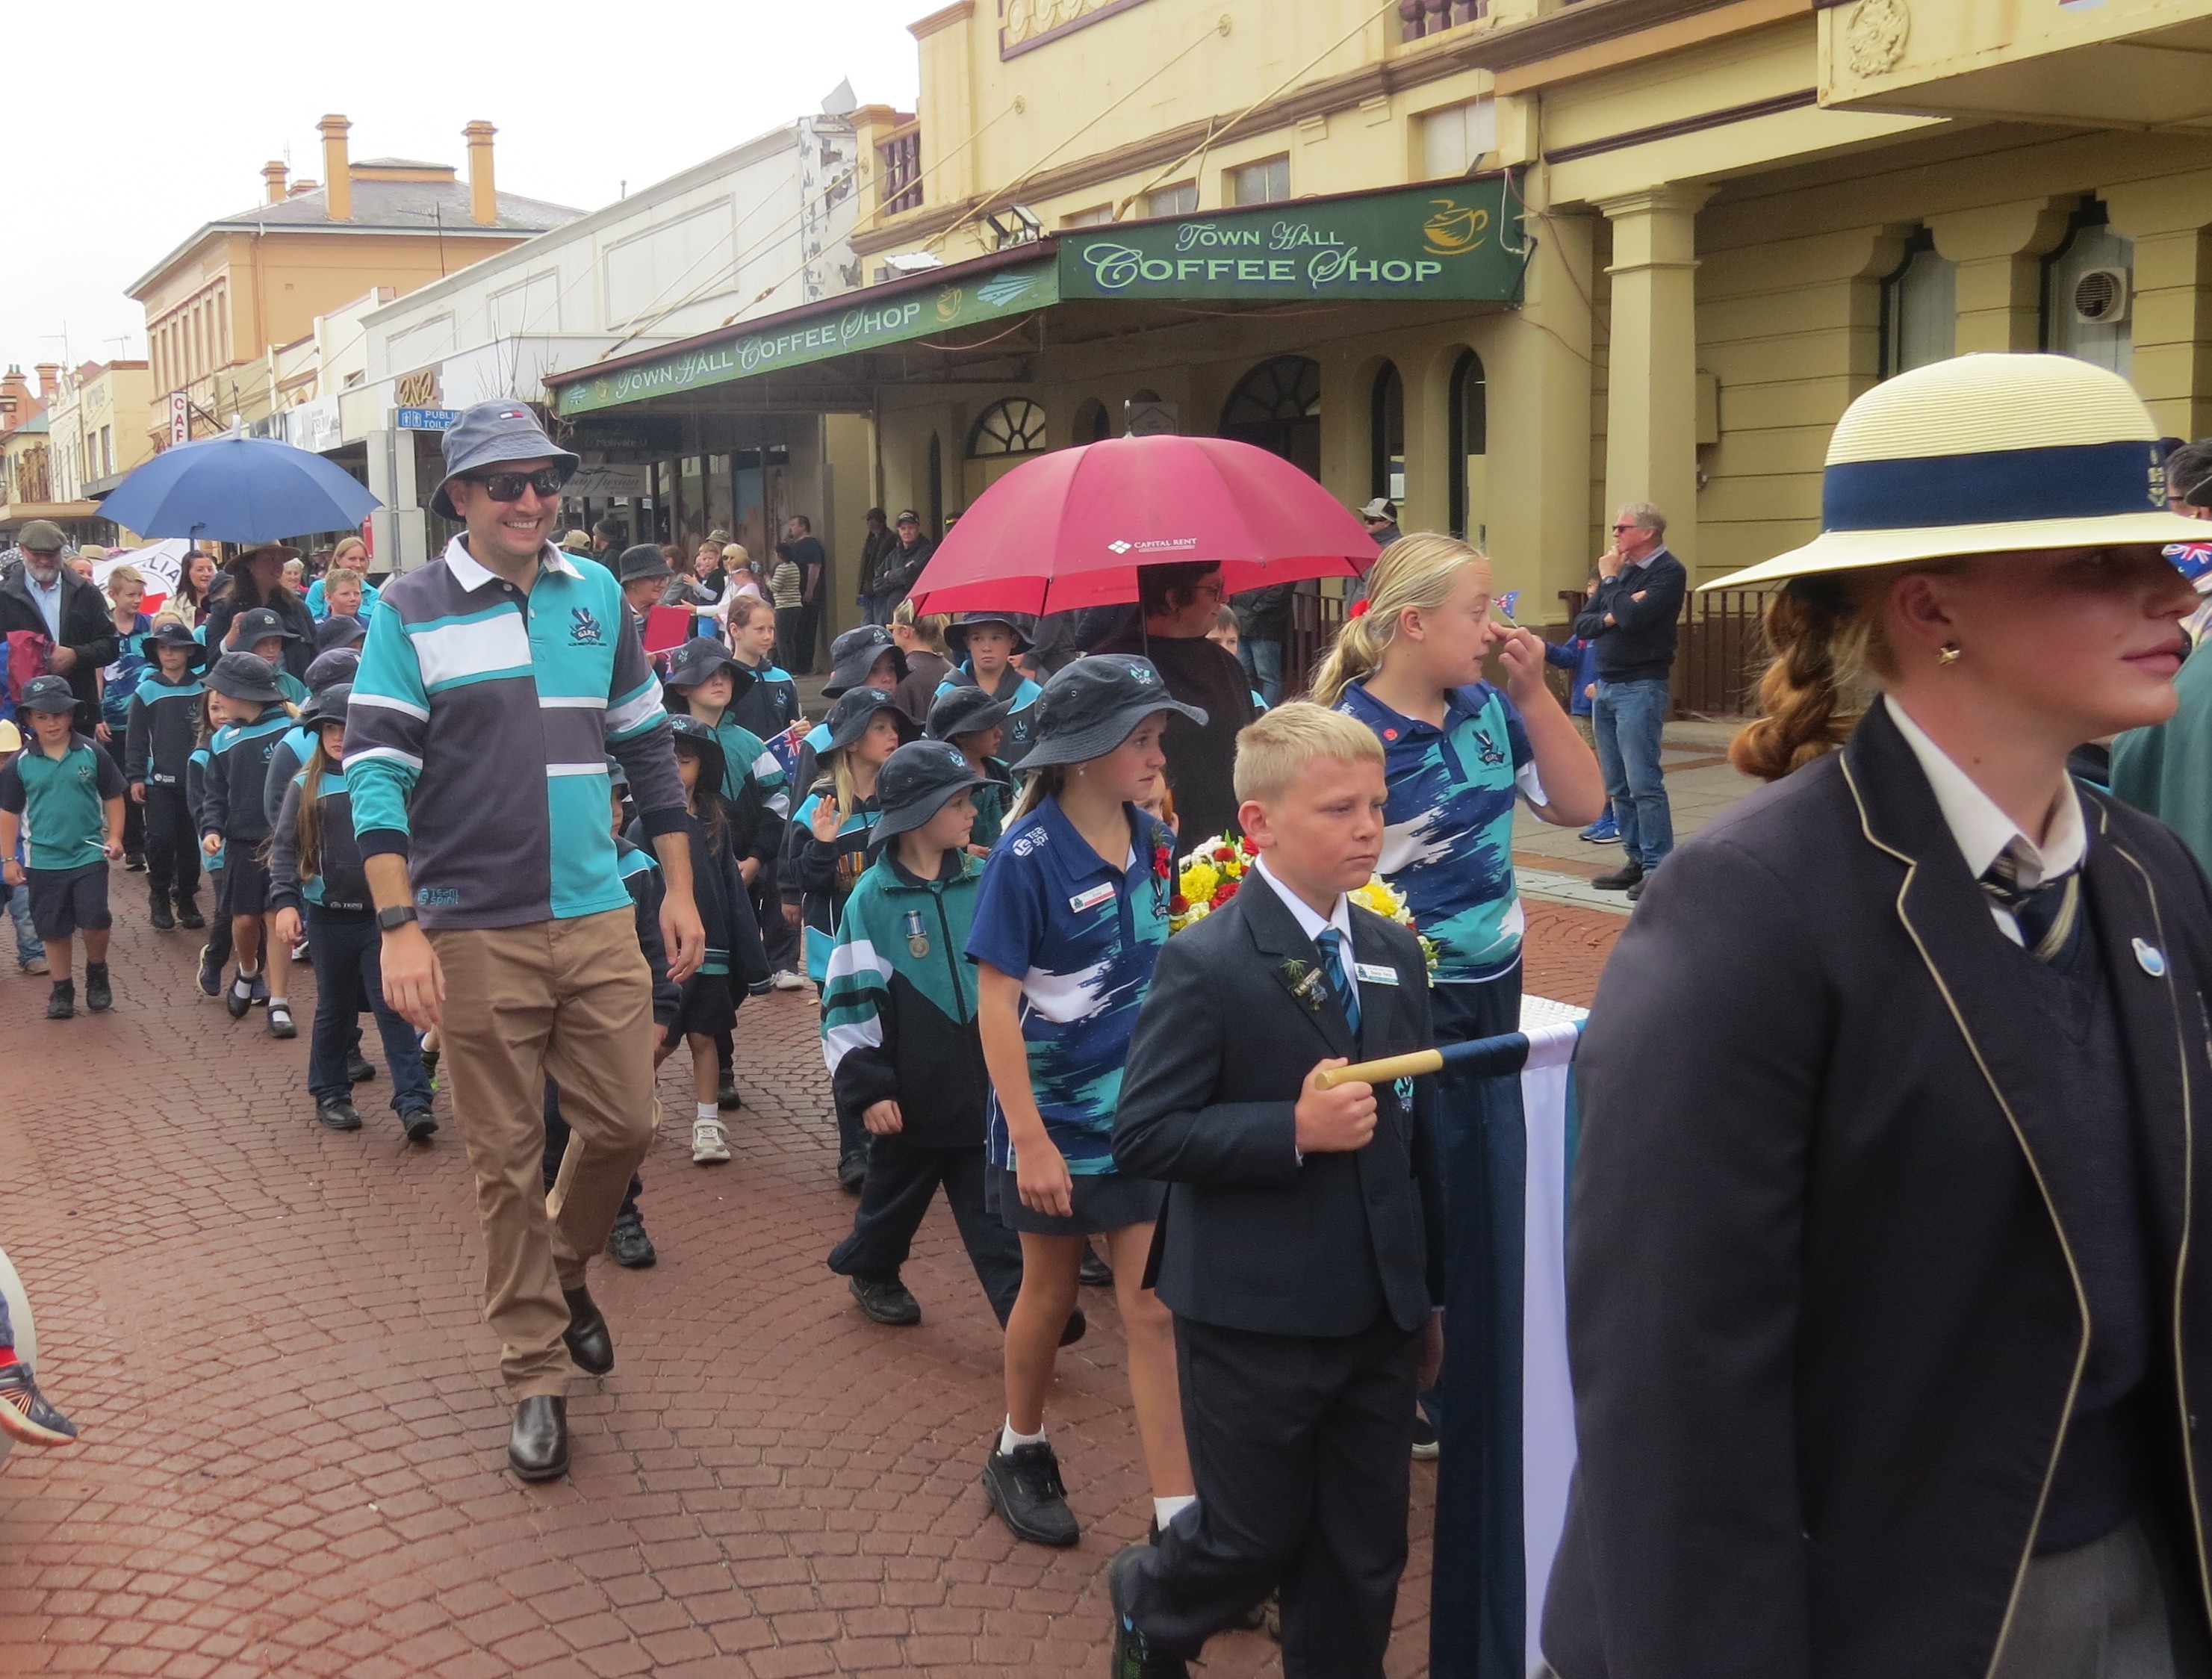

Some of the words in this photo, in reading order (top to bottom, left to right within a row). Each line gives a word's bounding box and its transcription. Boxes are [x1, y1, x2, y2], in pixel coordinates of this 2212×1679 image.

[1175, 223, 1260, 252] TOWN
[1269, 221, 1344, 251] HALL
[1083, 243, 1296, 289] COFFEE
[1307, 246, 1442, 290] SHOP
[736, 324, 836, 370] COFFEE
[840, 302, 921, 347] SHOP
[173, 397, 185, 442] CAF
[423, 420, 451, 429] TOILE
[1134, 539, 1172, 549] CAPITAL
[1173, 537, 1198, 545] RENT
[142, 556, 181, 583] LIA
